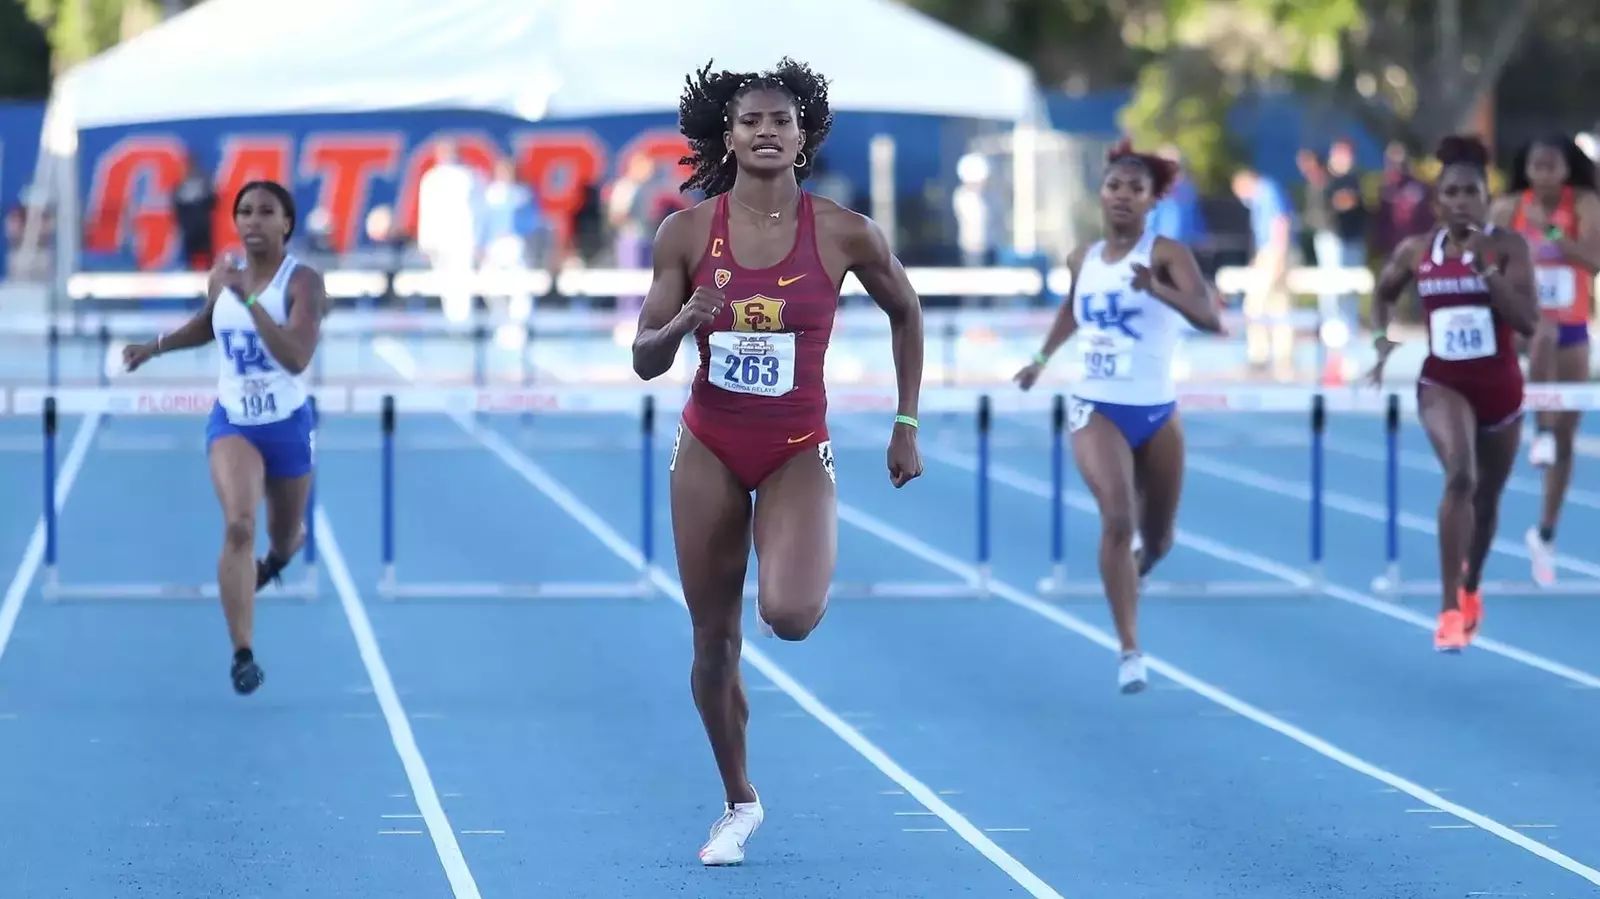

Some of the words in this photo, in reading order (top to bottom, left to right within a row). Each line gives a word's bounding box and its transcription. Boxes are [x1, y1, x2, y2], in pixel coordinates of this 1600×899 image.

[711, 238, 724, 257] C
[744, 303, 771, 331] SC
[1080, 289, 1143, 340] UK
[1445, 328, 1482, 352] 248
[724, 354, 779, 387] 263
[724, 381, 750, 392] FLORIDA
[240, 392, 277, 418] 194
